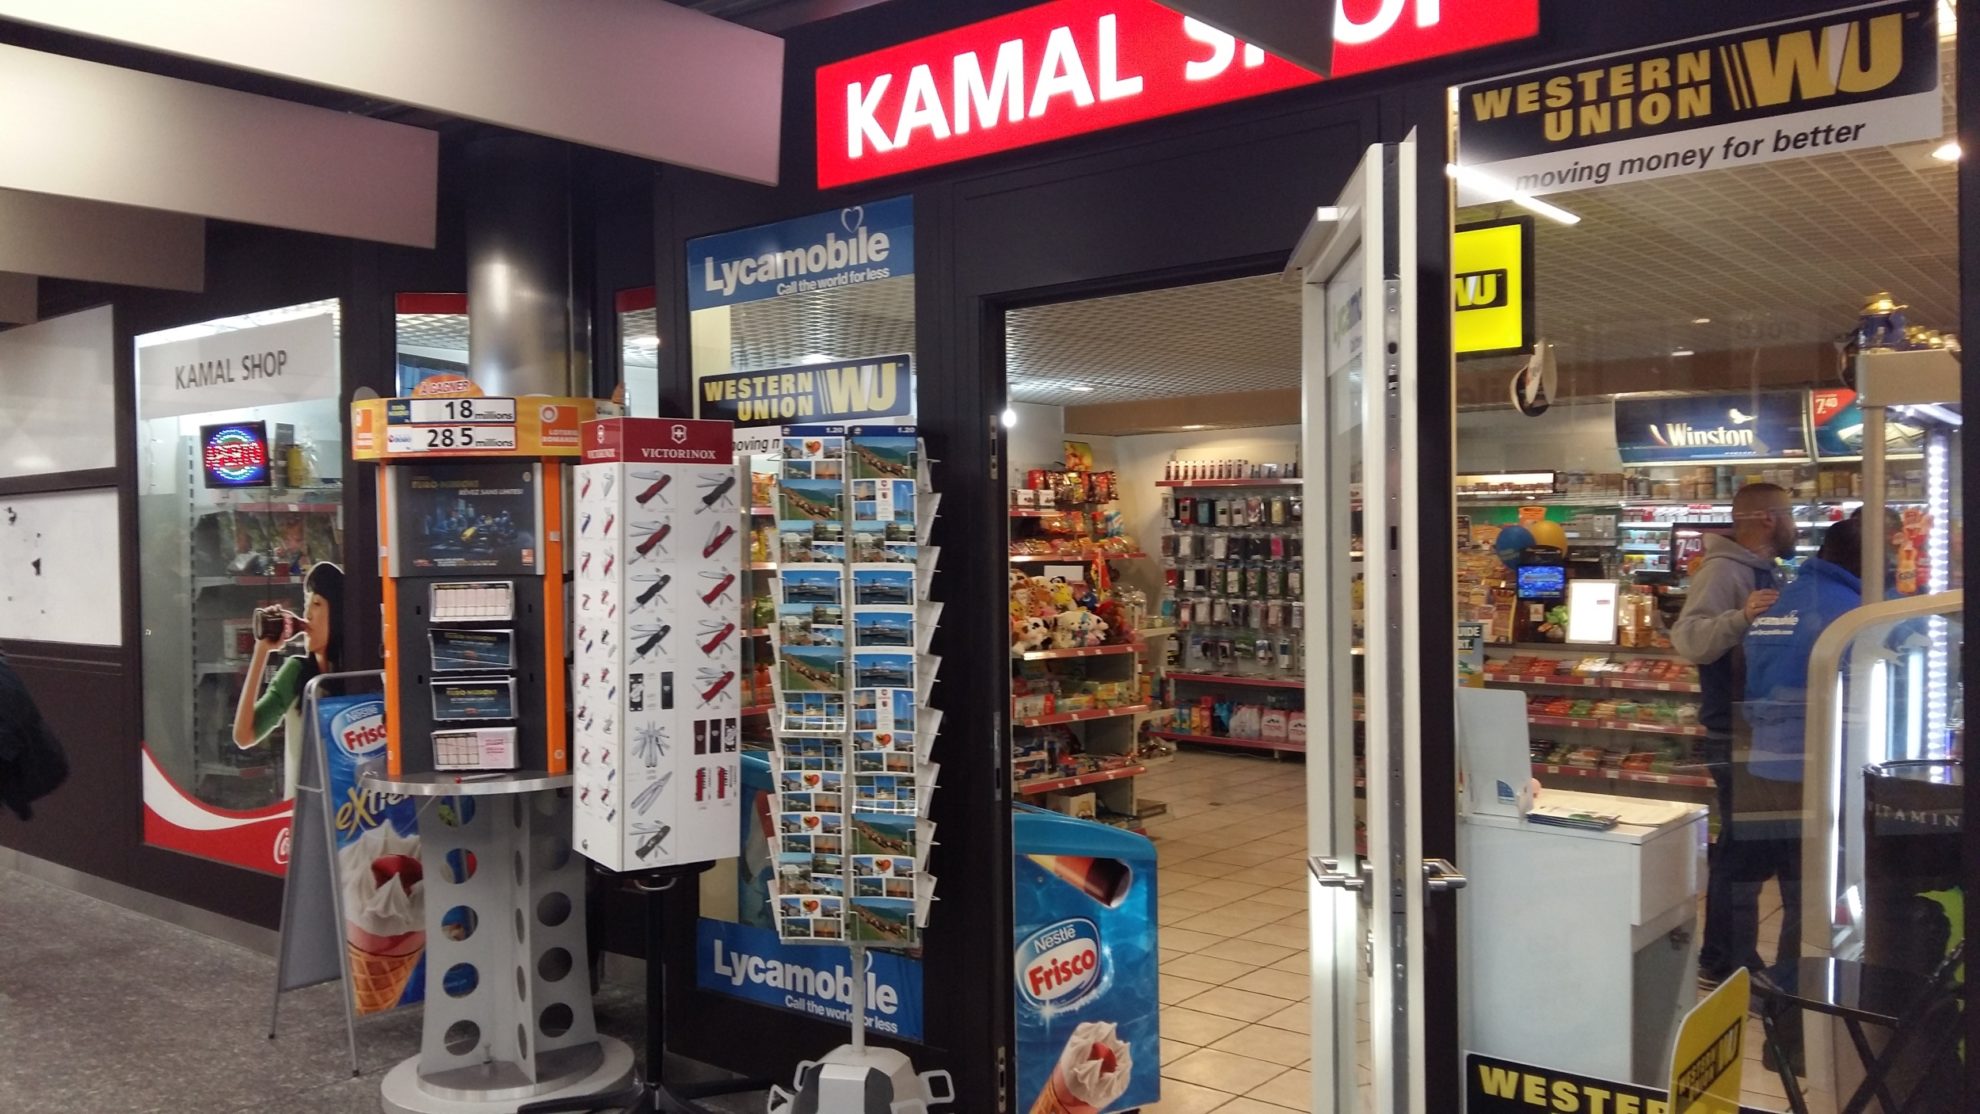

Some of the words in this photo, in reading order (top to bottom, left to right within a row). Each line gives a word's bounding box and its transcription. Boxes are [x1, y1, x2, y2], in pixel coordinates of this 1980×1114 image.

[845, 13, 1145, 159] KAMAL
[1472, 49, 1711, 122] WESTERN
[1742, 13, 1903, 107] WU
[1543, 85, 1711, 142] UNION
[1515, 160, 1610, 191] moving
[1619, 147, 1714, 178] money
[1721, 135, 1765, 161] for
[1772, 119, 1866, 154] better
[704, 226, 891, 296] Lycamobile
[776, 283, 798, 296] Call
[798, 279, 817, 293] the
[816, 272, 849, 290] world
[849, 270, 866, 284] for
[866, 266, 891, 280] less
[175, 358, 235, 390] KAMAL
[241, 350, 288, 380] SHOP
[704, 371, 814, 402] WESTERN
[825, 362, 898, 414] WU
[445, 399, 473, 420] 18
[475, 410, 513, 420] millions
[737, 395, 815, 422] UNION
[427, 427, 473, 448] 28.5
[475, 438, 514, 447] millions
[641, 447, 717, 460] VICTORINOX
[732, 436, 769, 453] oving
[1665, 422, 1754, 447] Winston
[343, 722, 388, 751] Frisc
[1033, 923, 1077, 954] Nestlé
[713, 939, 898, 1015] Lycamoble
[1028, 949, 1096, 997] Frisco
[784, 994, 806, 1010] Call
[807, 1000, 825, 1016] the
[863, 1015, 875, 1028] or
[875, 1016, 899, 1034] less
